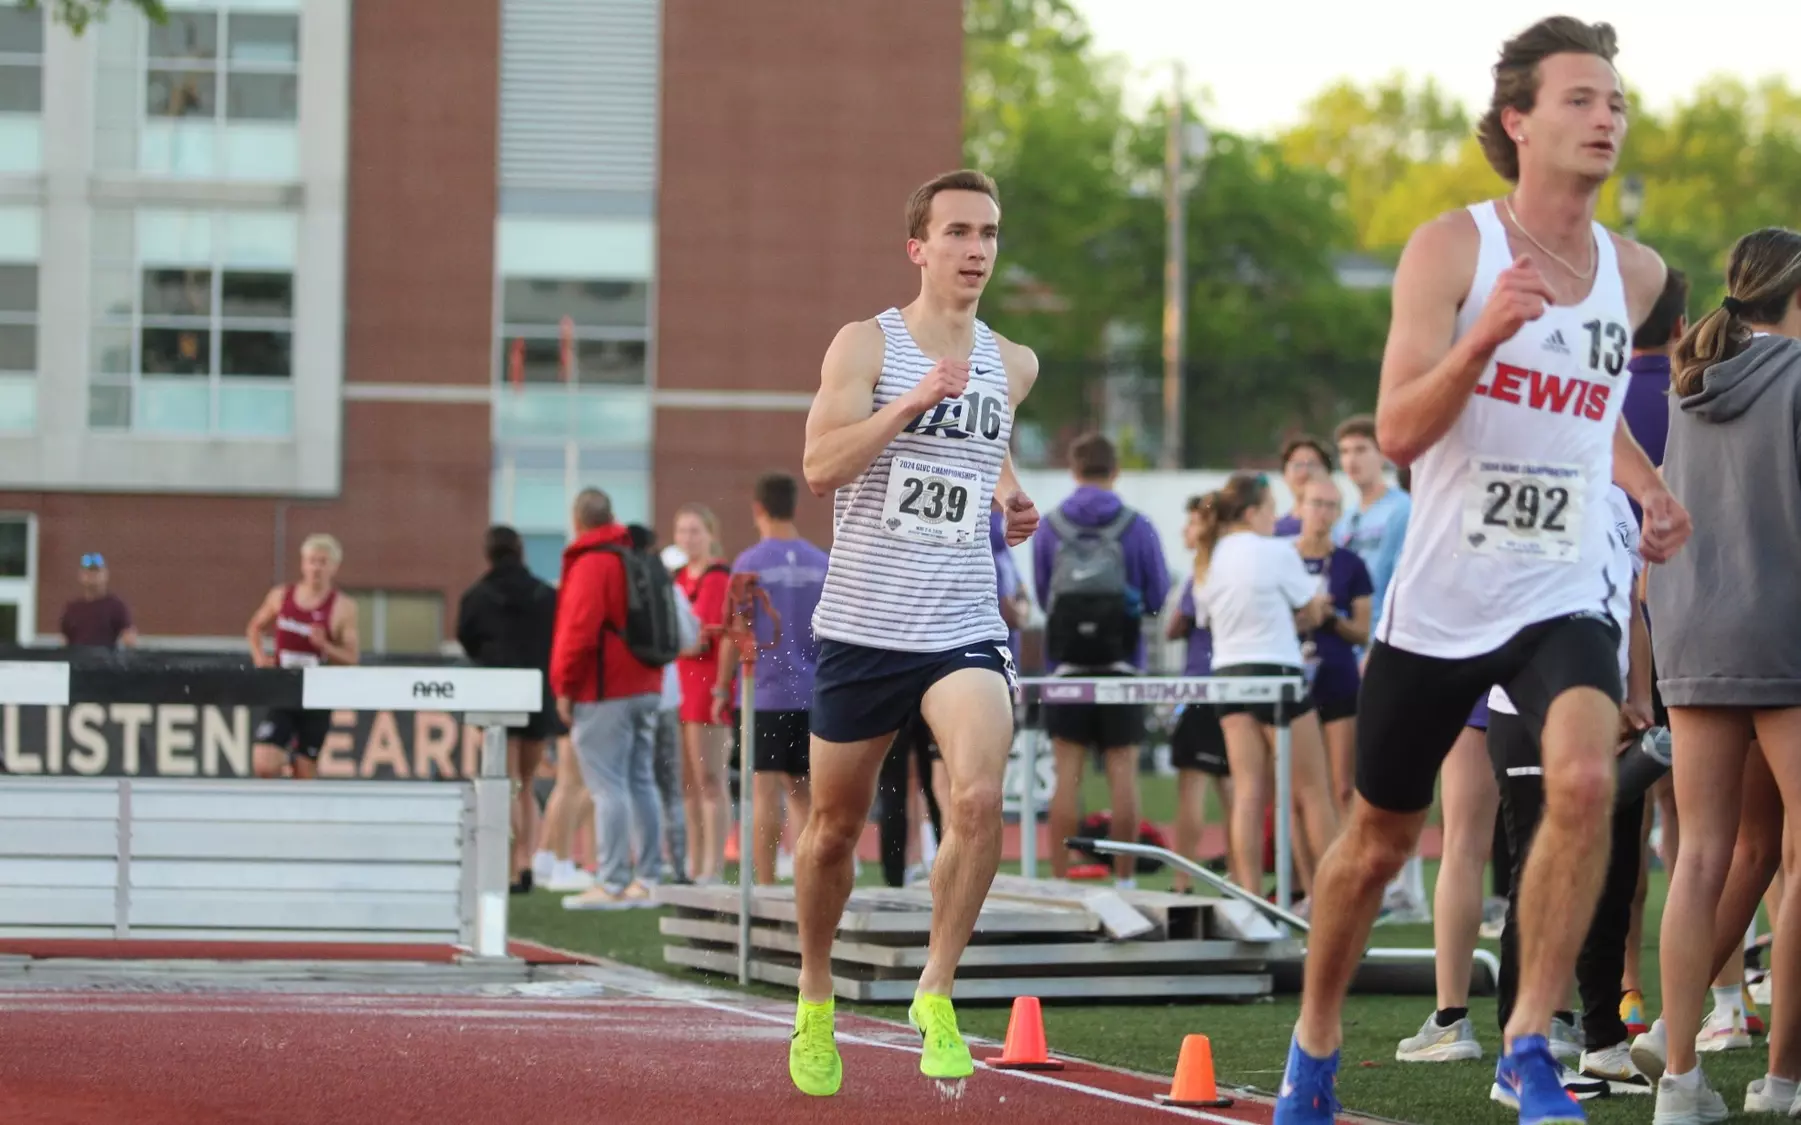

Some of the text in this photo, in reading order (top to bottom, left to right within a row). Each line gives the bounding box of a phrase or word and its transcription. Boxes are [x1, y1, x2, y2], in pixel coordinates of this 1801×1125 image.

[1583, 319, 1628, 377] 13
[963, 391, 1002, 440] 16
[1475, 361, 1610, 421] EWIS
[900, 460, 978, 481] 2024 GLVC CHAMPIONSHIPS
[899, 477, 968, 523] 239
[1483, 481, 1569, 532] 292
[4, 703, 250, 776] LISTEN
